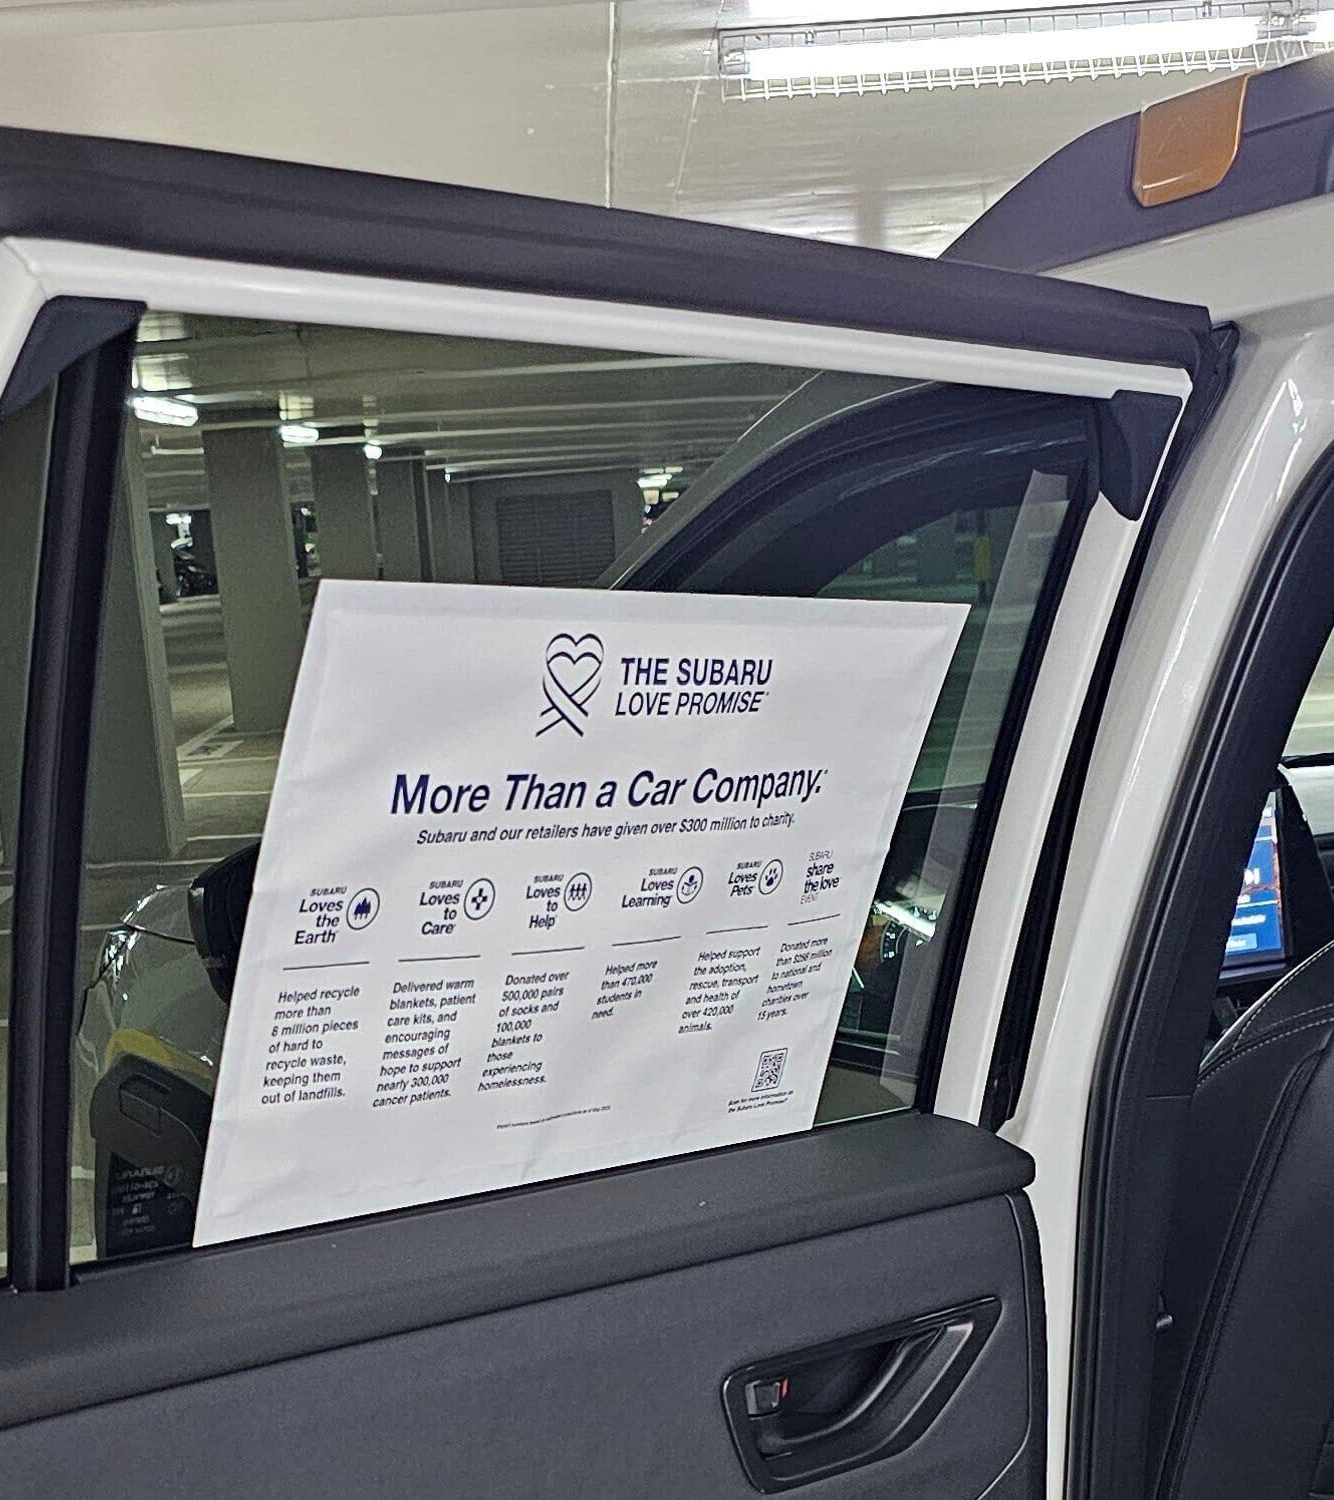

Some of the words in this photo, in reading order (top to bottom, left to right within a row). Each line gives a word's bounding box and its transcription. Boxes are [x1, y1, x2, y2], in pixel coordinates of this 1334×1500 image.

[621, 657, 669, 685] THE
[676, 658, 773, 686] SUBARU
[615, 692, 672, 716] LOVE
[390, 774, 490, 815] More
[505, 774, 587, 811] Than
[595, 780, 617, 808] a
[628, 770, 687, 807] Car
[416, 830, 467, 845] Subaru
[470, 827, 497, 842] and
[499, 828, 523, 841] our
[525, 825, 579, 839] retailers
[582, 823, 612, 838] have
[614, 822, 648, 840] given
[651, 822, 677, 835] over
[679, 818, 708, 833] $300
[709, 817, 748, 831] million
[750, 816, 761, 829] to
[762, 811, 796, 828] charity.
[648, 867, 678, 877] SUBARU
[736, 861, 763, 870] SUBARU
[806, 862, 835, 878] share
[429, 879, 464, 890] SUBARU
[533, 874, 564, 883] SUBARU
[640, 878, 675, 892] Loves
[728, 872, 758, 885] Loves
[803, 879, 819, 894] the
[819, 875, 840, 890] love
[310, 886, 348, 897] SUBARU
[525, 885, 561, 900] Loves
[730, 884, 755, 897] Pets
[299, 899, 344, 913] Loves
[419, 891, 461, 906] Loves
[546, 900, 558, 912] to
[621, 893, 672, 909] Learning
[316, 914, 340, 928] the
[443, 907, 457, 921] to
[421, 921, 455, 936] Care
[528, 914, 556, 930] Help
[294, 930, 337, 945] Earth
[697, 950, 727, 962] Helped
[728, 946, 761, 960] support
[605, 962, 636, 976] Helped
[636, 960, 658, 971] more
[693, 967, 707, 976] the
[505, 973, 547, 986] Donated
[548, 971, 570, 982] over
[601, 980, 620, 990] than
[721, 974, 759, 987] transport
[392, 980, 444, 994] Delivered
[446, 979, 475, 990] warm
[501, 989, 539, 1002] 500,000
[540, 986, 564, 1001] pairs
[277, 988, 318, 1005] Helped
[319, 985, 361, 1001] recycle
[389, 998, 437, 1011] blankets,
[439, 993, 477, 1009] patient
[596, 992, 632, 1005] students
[633, 989, 642, 998] in
[685, 994, 702, 1005] and
[703, 991, 728, 1003] health
[730, 989, 740, 1000] of
[274, 1008, 304, 1020] more
[307, 1005, 332, 1017] than
[498, 1006, 510, 1017] of
[511, 1004, 539, 1017] socks
[541, 1001, 560, 1013] and
[681, 1010, 701, 1019] over
[387, 1016, 411, 1027] care
[413, 1013, 435, 1025] kits,
[437, 1010, 458, 1022] and
[496, 1019, 532, 1033] 100,000
[271, 1025, 279, 1037] 8
[281, 1023, 319, 1036] million
[322, 1020, 359, 1035] pieces
[384, 1028, 451, 1044] encouraging
[268, 1041, 281, 1054] of
[283, 1039, 309, 1052] hard
[312, 1039, 323, 1049] to
[491, 1035, 531, 1048] blankets
[532, 1033, 543, 1043] to
[382, 1046, 435, 1060] messages
[438, 1043, 450, 1055] of
[486, 1051, 513, 1063] those
[265, 1057, 307, 1072] recycle
[310, 1054, 347, 1067] waste,
[379, 1065, 407, 1078] hope
[409, 1063, 420, 1073] to
[421, 1057, 462, 1073] support
[482, 1061, 543, 1078] experiencing
[262, 1073, 309, 1089] keeping
[313, 1070, 341, 1084] them
[376, 1079, 410, 1092] nearly
[410, 1073, 450, 1088] 300,000
[477, 1075, 547, 1092] homelessness.
[261, 1092, 280, 1104] out
[283, 1090, 296, 1103] of
[298, 1086, 346, 1101] landfills.
[372, 1095, 409, 1108] cancer
